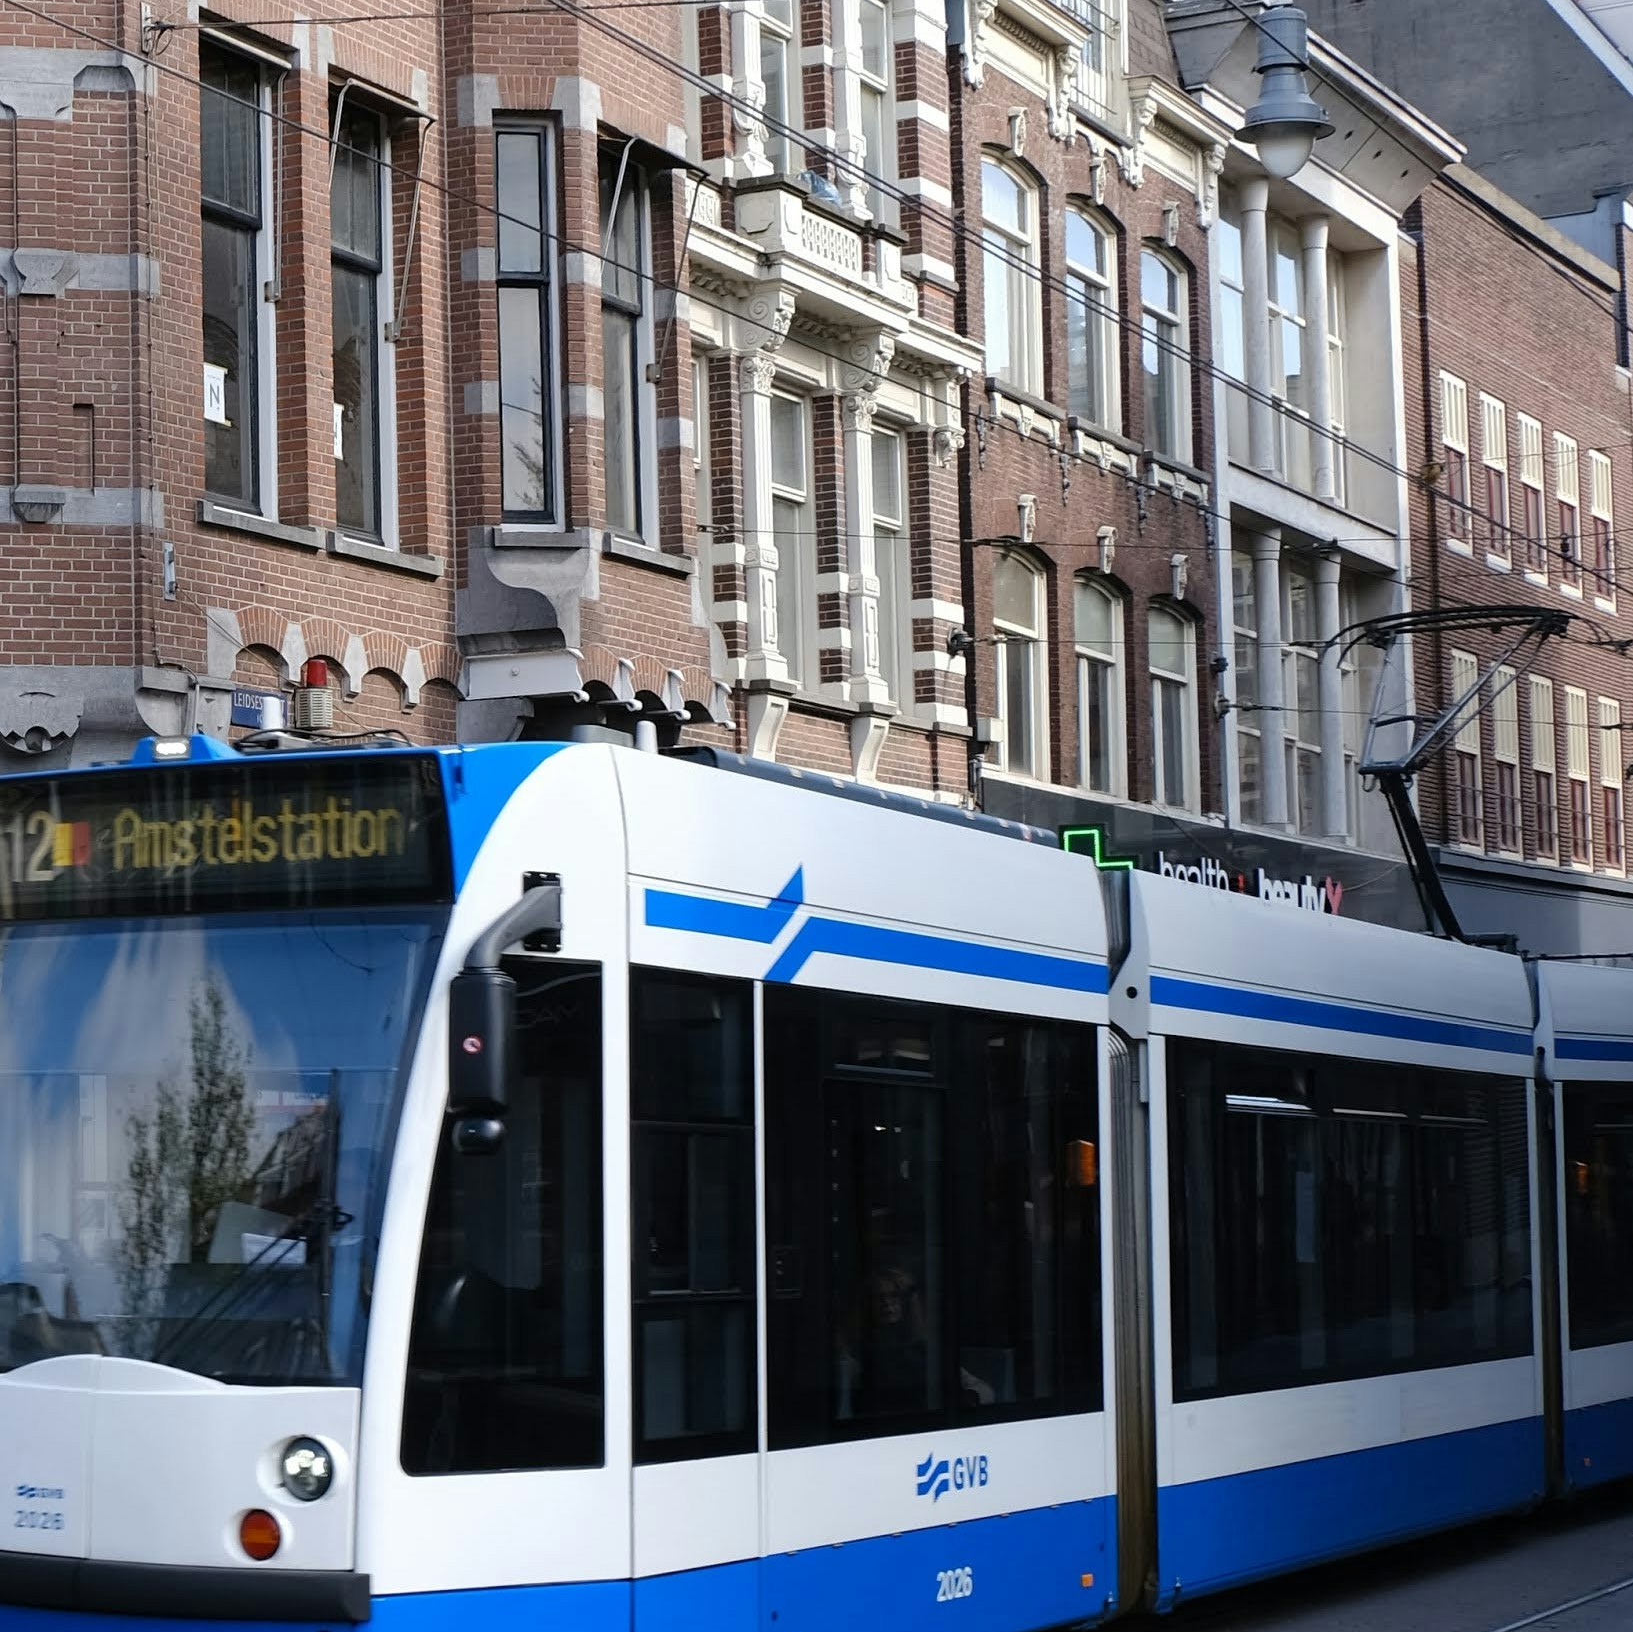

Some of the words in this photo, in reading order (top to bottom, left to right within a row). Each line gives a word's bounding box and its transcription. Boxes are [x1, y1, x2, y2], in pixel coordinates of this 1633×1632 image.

[234, 692, 285, 714] LEIDSEST
[113, 795, 404, 869] Amstelstation
[953, 1454, 989, 1490] GVB
[936, 1566, 974, 1602] 2026
